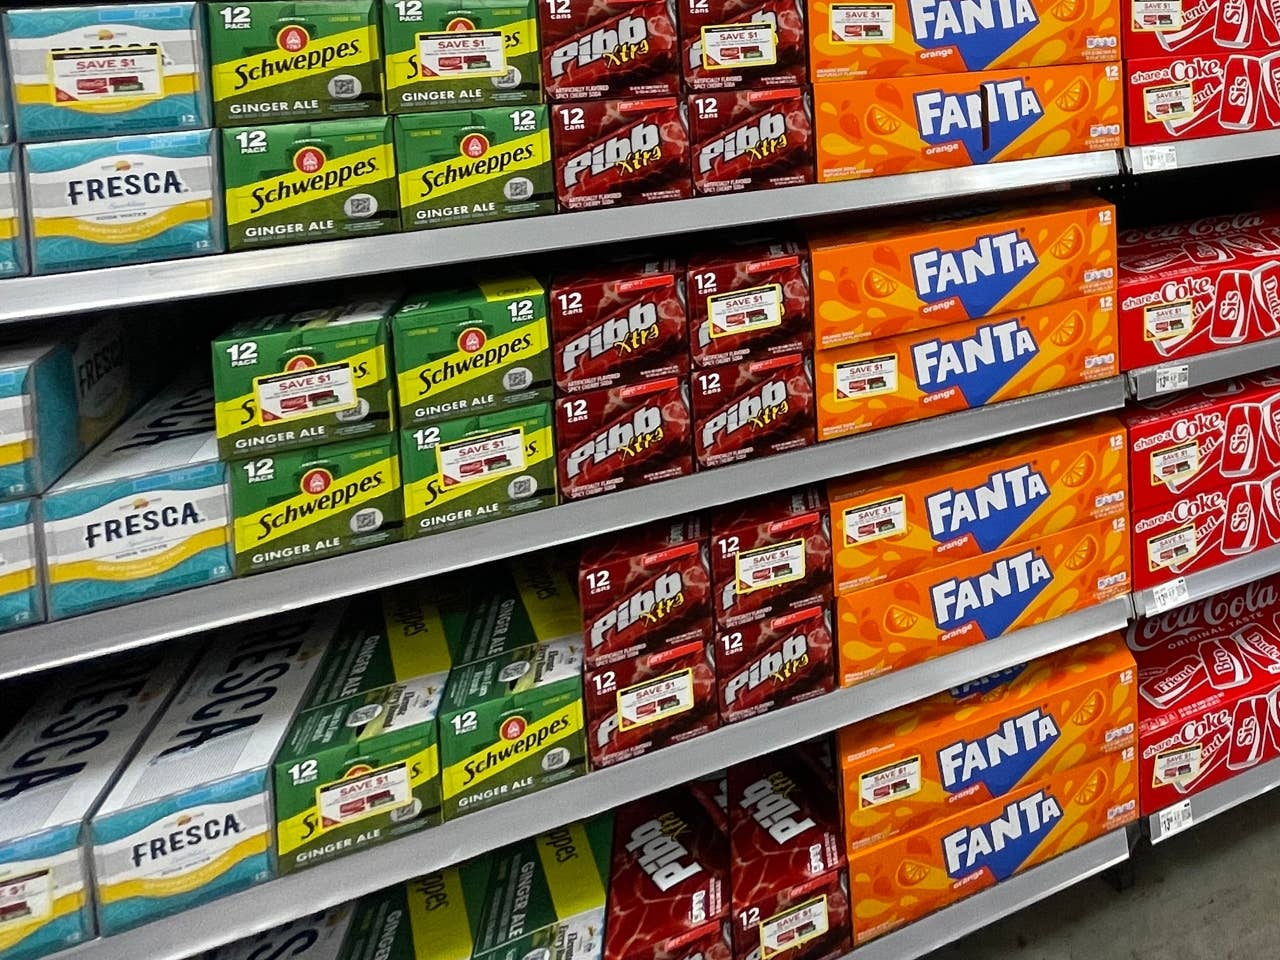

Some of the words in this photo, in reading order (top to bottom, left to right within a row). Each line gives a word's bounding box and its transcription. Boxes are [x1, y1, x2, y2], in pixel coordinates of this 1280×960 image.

[845, 10, 870, 18] SAVE
[872, 10, 880, 18] $1
[235, 38, 360, 89] Schweppes
[550, 13, 647, 77] Pibb
[230, 101, 289, 114] GINGER
[294, 99, 319, 110] ALE
[68, 169, 181, 205] FRESCA
[251, 157, 377, 213] Schweppes
[421, 143, 534, 197] Schweppes
[911, 230, 1036, 296] FANTA
[1160, 276, 1212, 304] Coke
[564, 301, 657, 372] Pibb
[419, 332, 533, 396] Schweppes
[703, 378, 788, 448] Pibb
[85, 502, 199, 548] FRESCA
[257, 471, 383, 540] Schweppes
[928, 466, 1047, 535] FANTA
[591, 569, 683, 648] Pibb
[1168, 626, 1225, 650] ORIGINAL
[1229, 612, 1264, 627] TASTE
[1216, 647, 1234, 675] Bro
[1249, 632, 1280, 657] Dude
[1156, 665, 1195, 693] Friend
[450, 711, 477, 730] 12
[463, 715, 569, 785] Schweppes
[458, 786, 508, 808] GINGER
[512, 777, 533, 791] ALE
[132, 813, 240, 866] FRESCA
[625, 818, 703, 892] Pibb
[943, 794, 1061, 873] FANTA
[515, 861, 536, 910] GINGER
[509, 908, 526, 939] ALE
